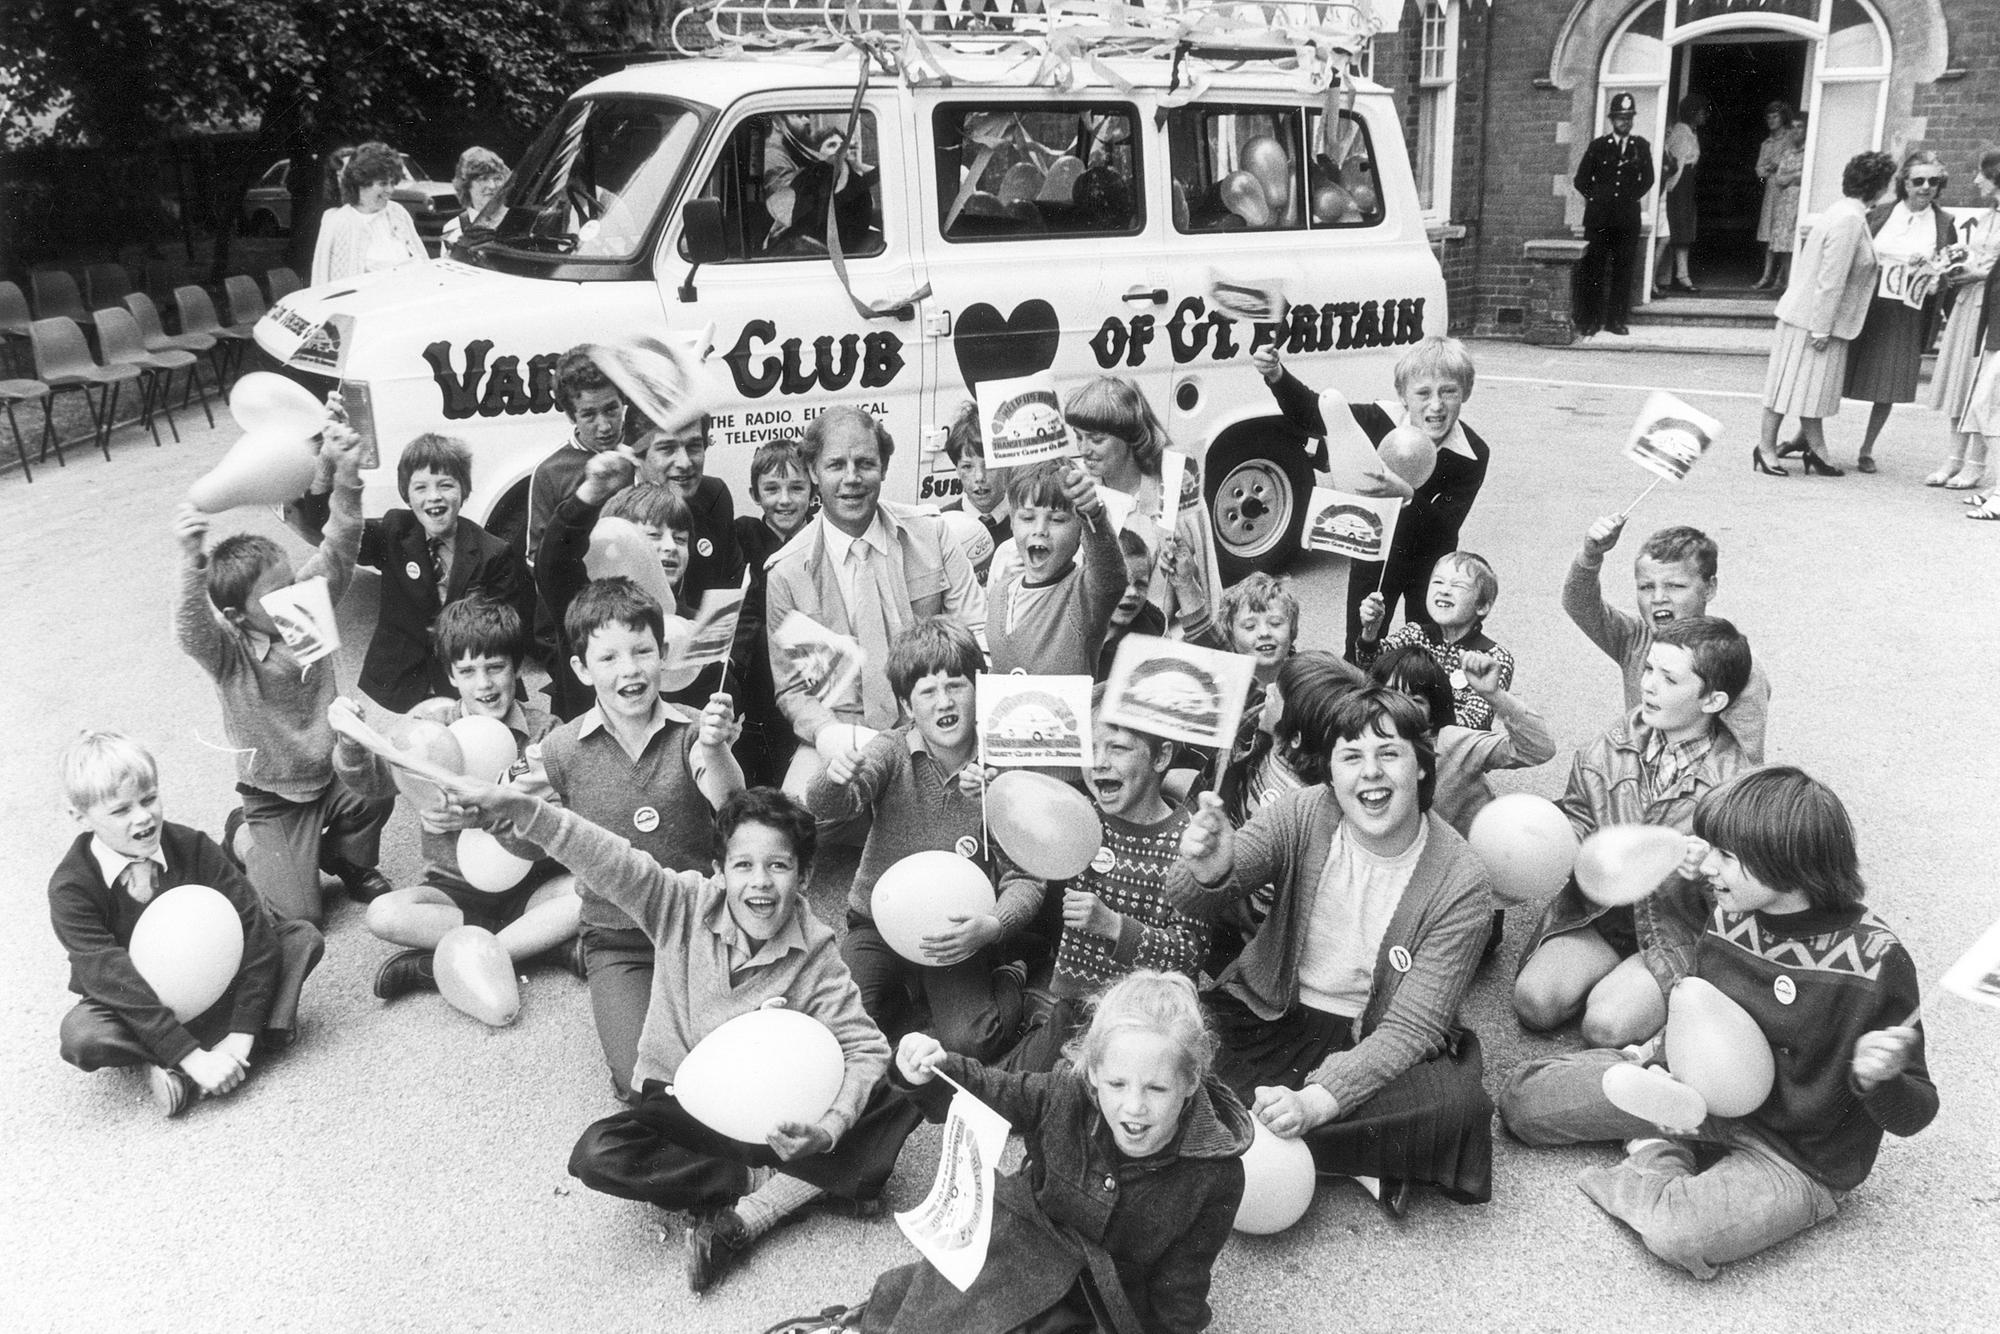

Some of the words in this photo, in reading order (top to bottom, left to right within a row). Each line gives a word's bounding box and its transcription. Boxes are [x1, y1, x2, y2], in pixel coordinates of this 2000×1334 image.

[722, 319, 905, 398] CLUB
[1089, 316, 1155, 369] OF
[710, 415, 735, 429] THE
[745, 410, 790, 426] RADIO
